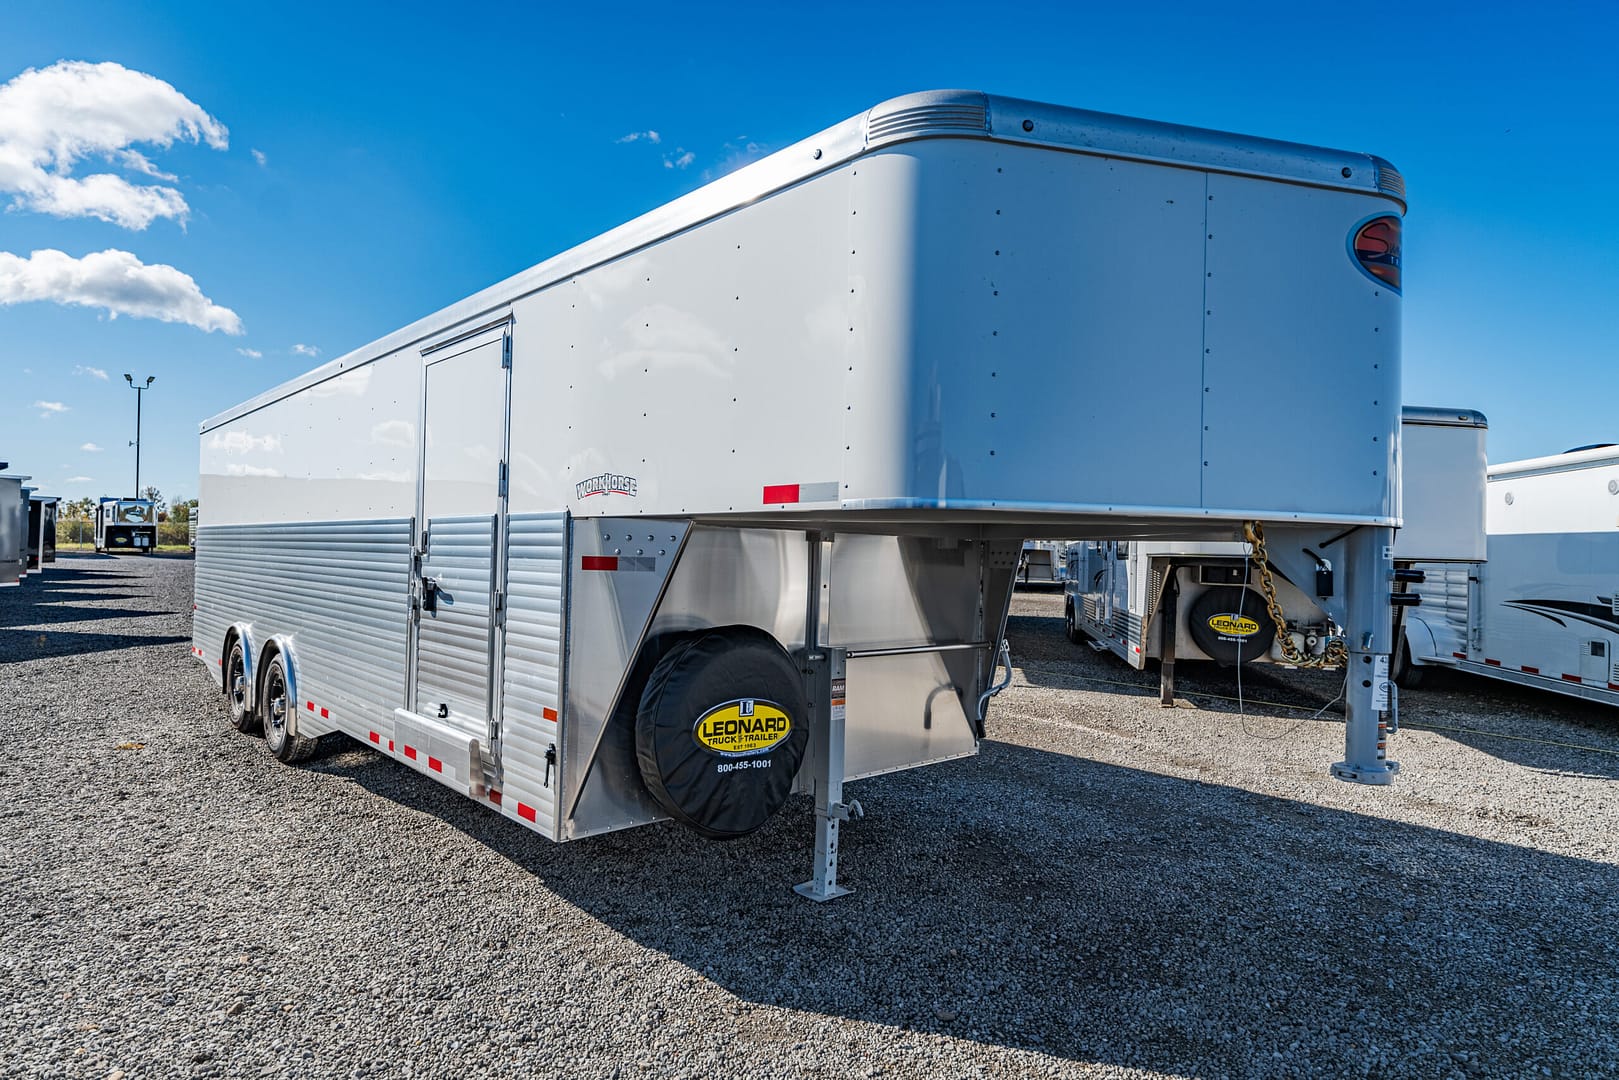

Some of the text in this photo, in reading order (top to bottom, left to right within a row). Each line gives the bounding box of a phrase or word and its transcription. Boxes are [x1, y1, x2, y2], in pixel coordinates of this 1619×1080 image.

[576, 473, 637, 500] WORKHORSE
[1211, 619, 1257, 630] LEONARD
[703, 718, 786, 737] LEONARD
[708, 735, 737, 745] TRUCK
[744, 733, 778, 742] TRAILER
[717, 760, 772, 773] 800-455-1001
